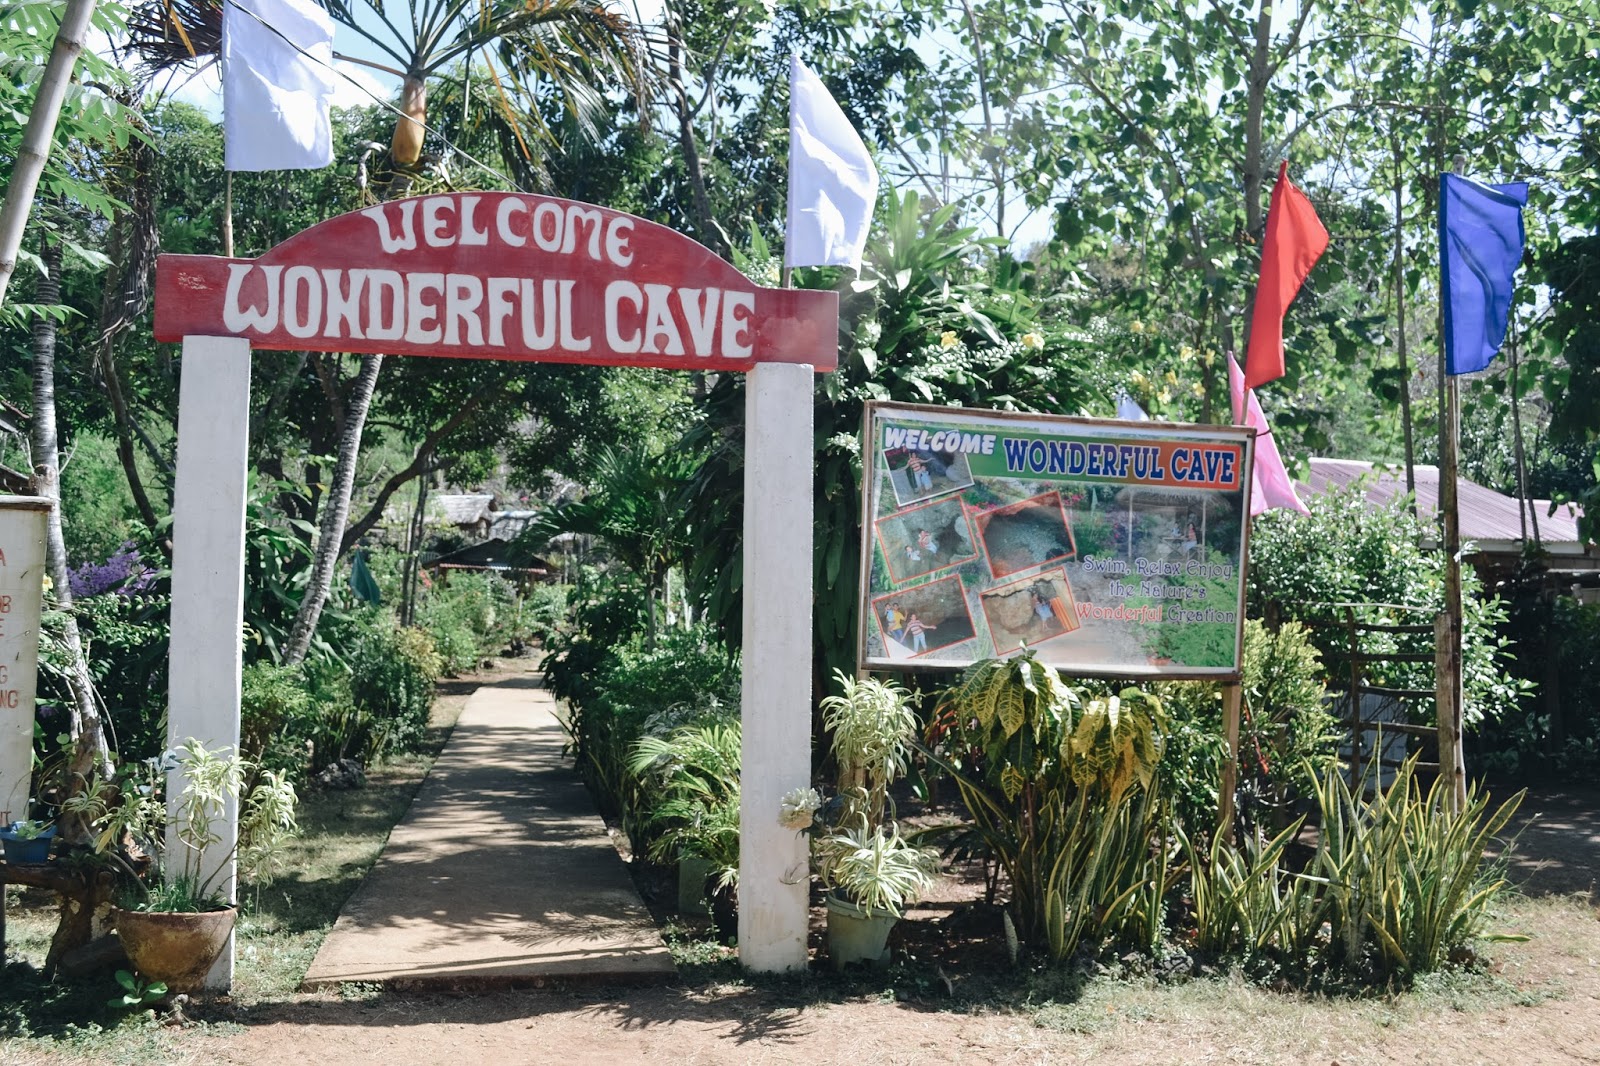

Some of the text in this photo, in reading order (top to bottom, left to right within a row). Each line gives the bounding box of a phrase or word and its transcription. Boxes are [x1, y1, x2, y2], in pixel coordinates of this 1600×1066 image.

[362, 196, 636, 267] WELCOME
[223, 263, 755, 358] WONDERFUL CAVE
[884, 427, 1235, 483] WELCOME WONDERFUL CAVE
[1082, 555, 1233, 581] Swim, Relax Enjoy
[1109, 580, 1207, 599] the Nature's
[1076, 602, 1234, 624] Wonderful Creation
